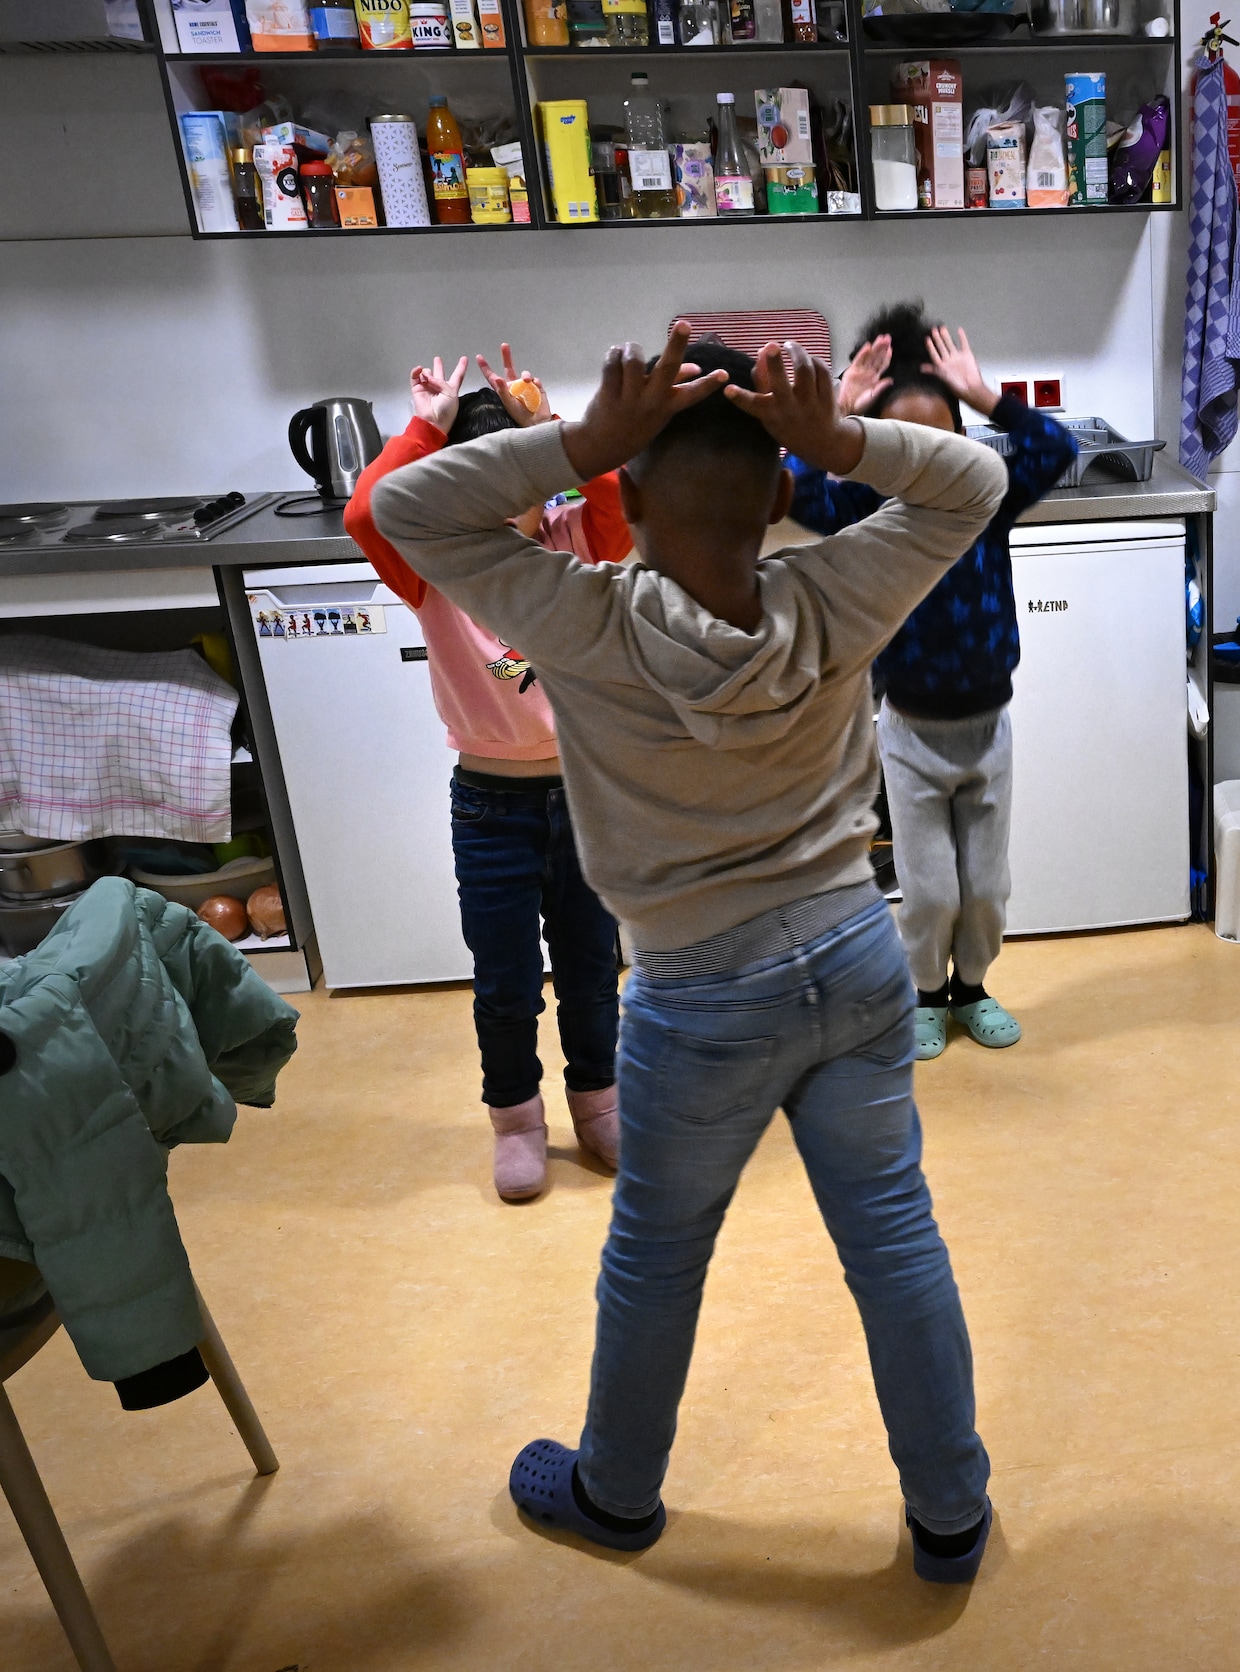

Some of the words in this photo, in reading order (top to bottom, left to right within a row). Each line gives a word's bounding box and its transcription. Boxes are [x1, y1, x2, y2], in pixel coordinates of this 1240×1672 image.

[359, 0, 402, 12] NIDO
[412, 26, 441, 37] KING
[192, 36, 224, 44] TOASTER
